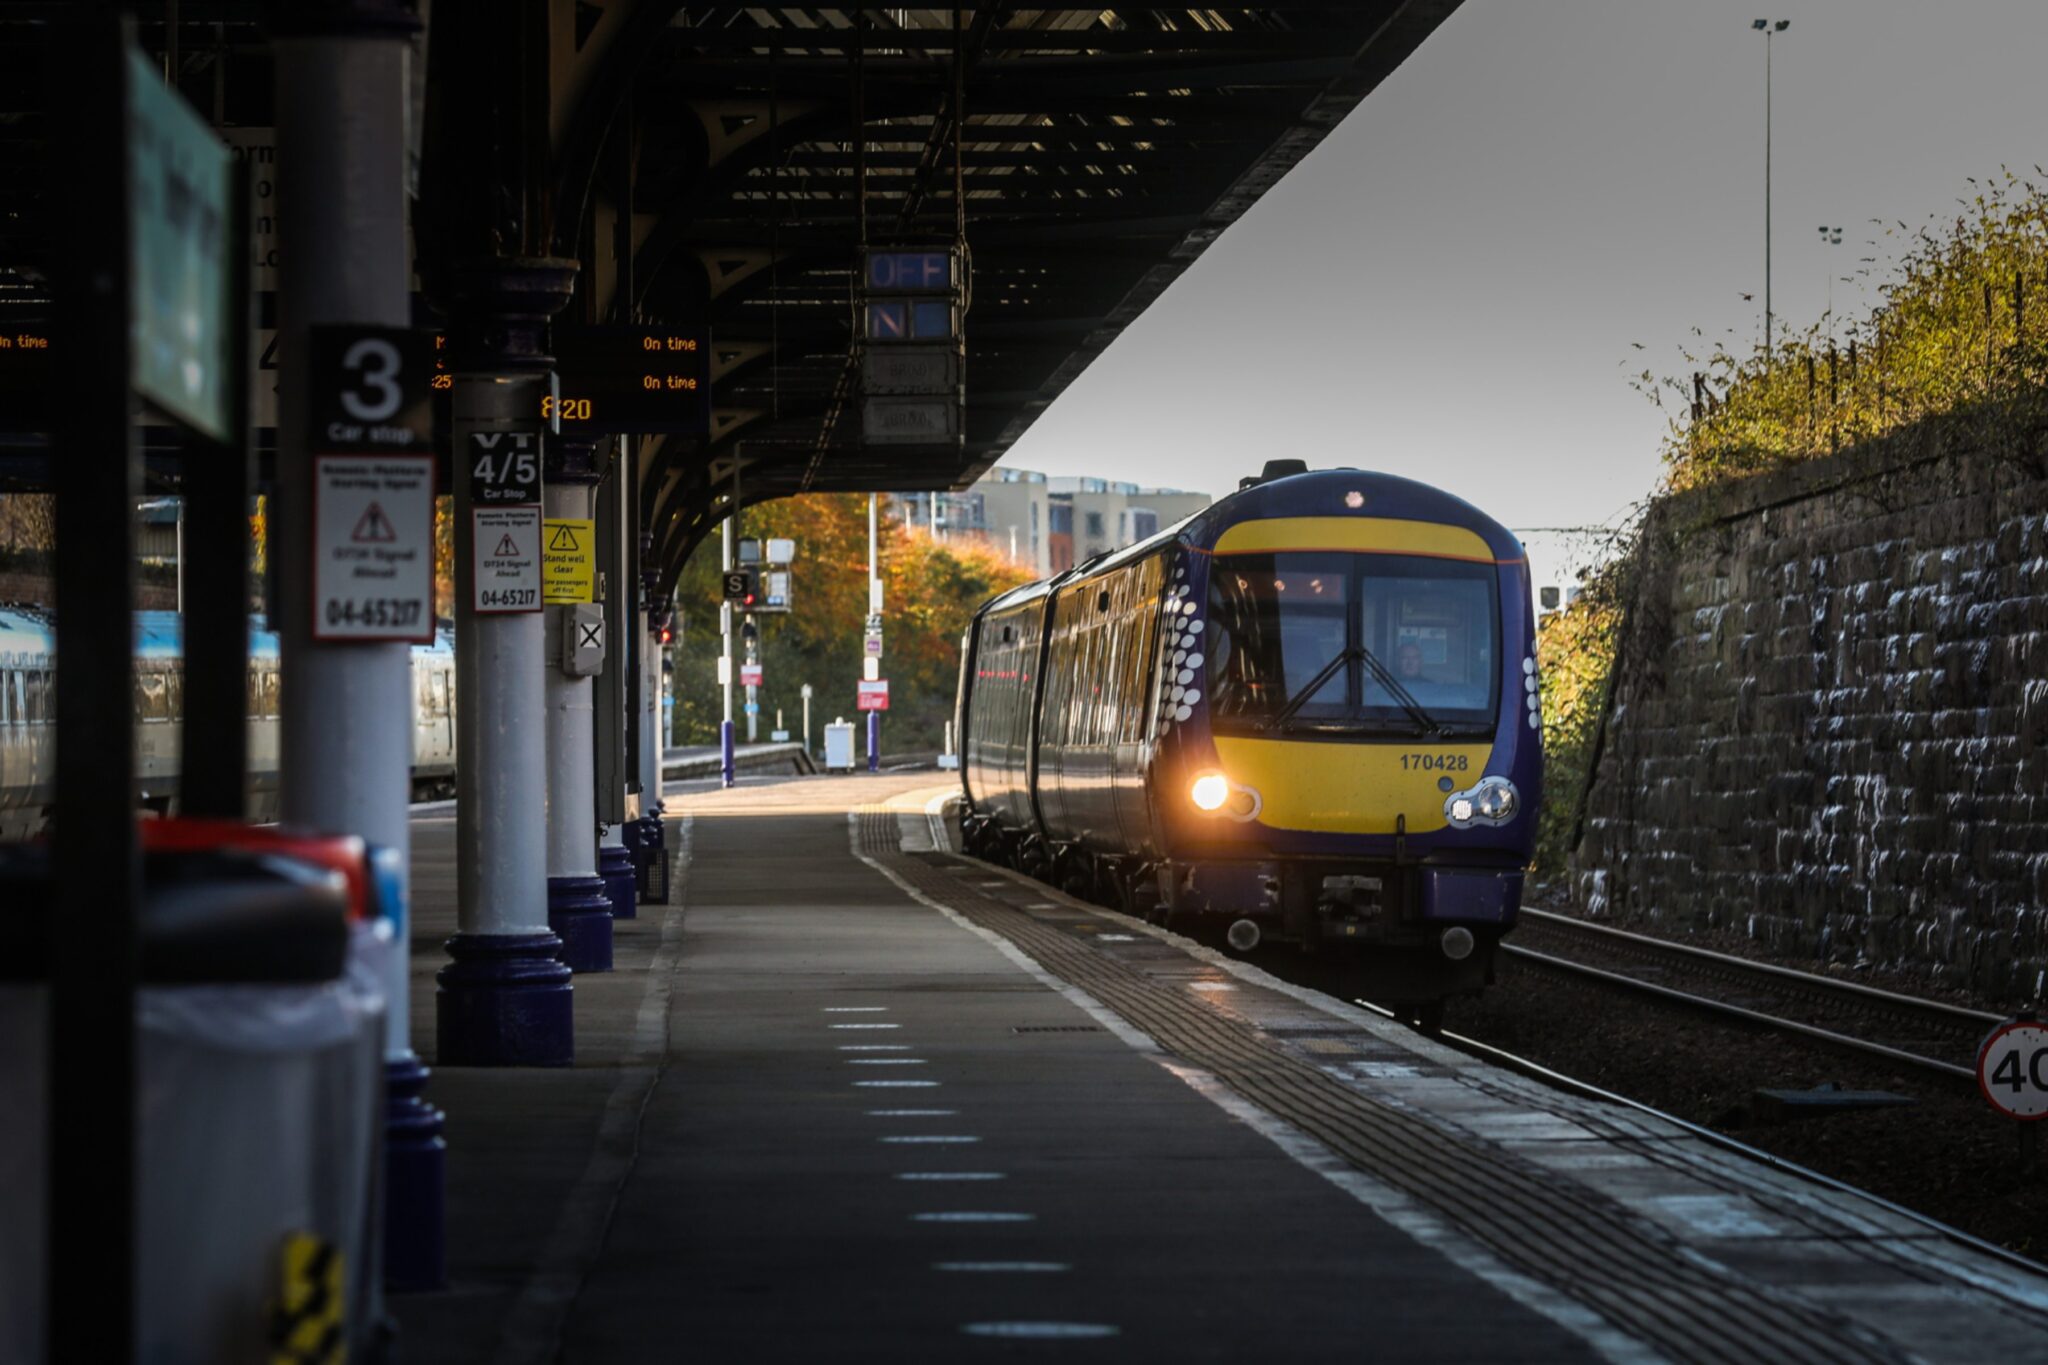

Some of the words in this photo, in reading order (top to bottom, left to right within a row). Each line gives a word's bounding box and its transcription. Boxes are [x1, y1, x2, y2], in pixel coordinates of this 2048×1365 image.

[872, 253, 942, 288] OFF
[873, 307, 907, 338] N
[17, 333, 48, 349] time
[643, 336, 661, 351] On
[667, 336, 697, 351] time
[339, 337, 404, 422] 3
[643, 375, 661, 390] On
[667, 375, 697, 390] time
[327, 421, 364, 442] Car
[473, 451, 536, 484] 4/5
[483, 488, 502, 499] Car
[503, 488, 527, 501] Stop
[544, 554, 567, 563] Stand
[568, 554, 585, 564] well
[553, 565, 574, 574] clear
[728, 575, 743, 593] S
[481, 589, 537, 606] 04-65217
[325, 597, 422, 627] 04-65217
[1400, 754, 1468, 771] 170428
